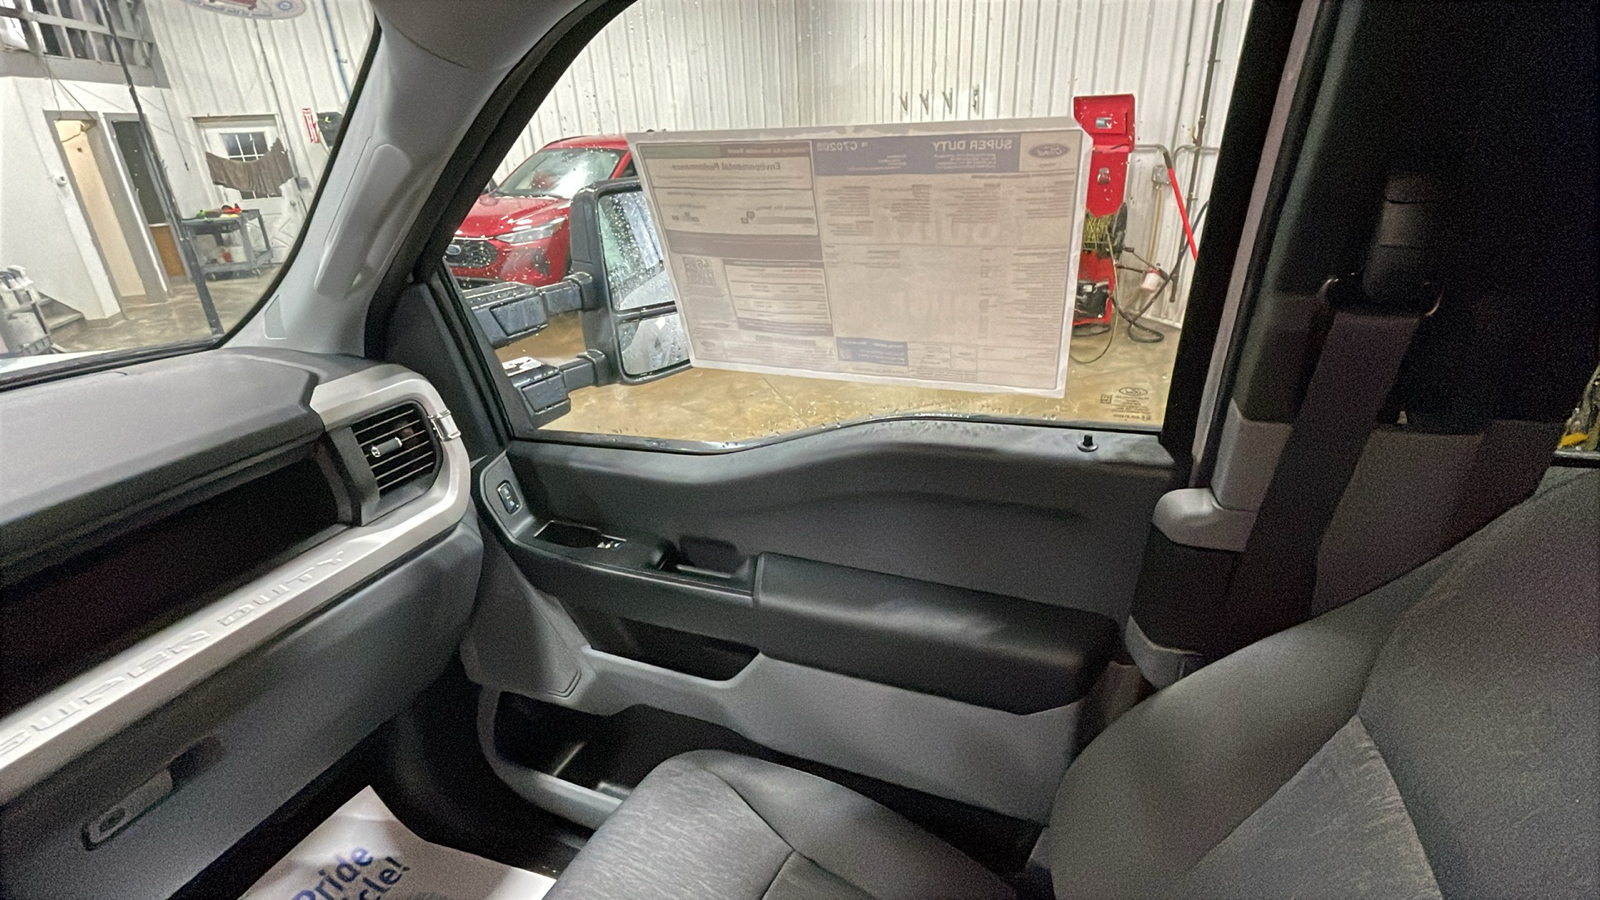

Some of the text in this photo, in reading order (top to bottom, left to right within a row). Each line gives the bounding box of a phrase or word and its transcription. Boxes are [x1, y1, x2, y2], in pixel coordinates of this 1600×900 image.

[0, 551, 344, 758] SUPER DUTY
[343, 856, 410, 900] cle!
